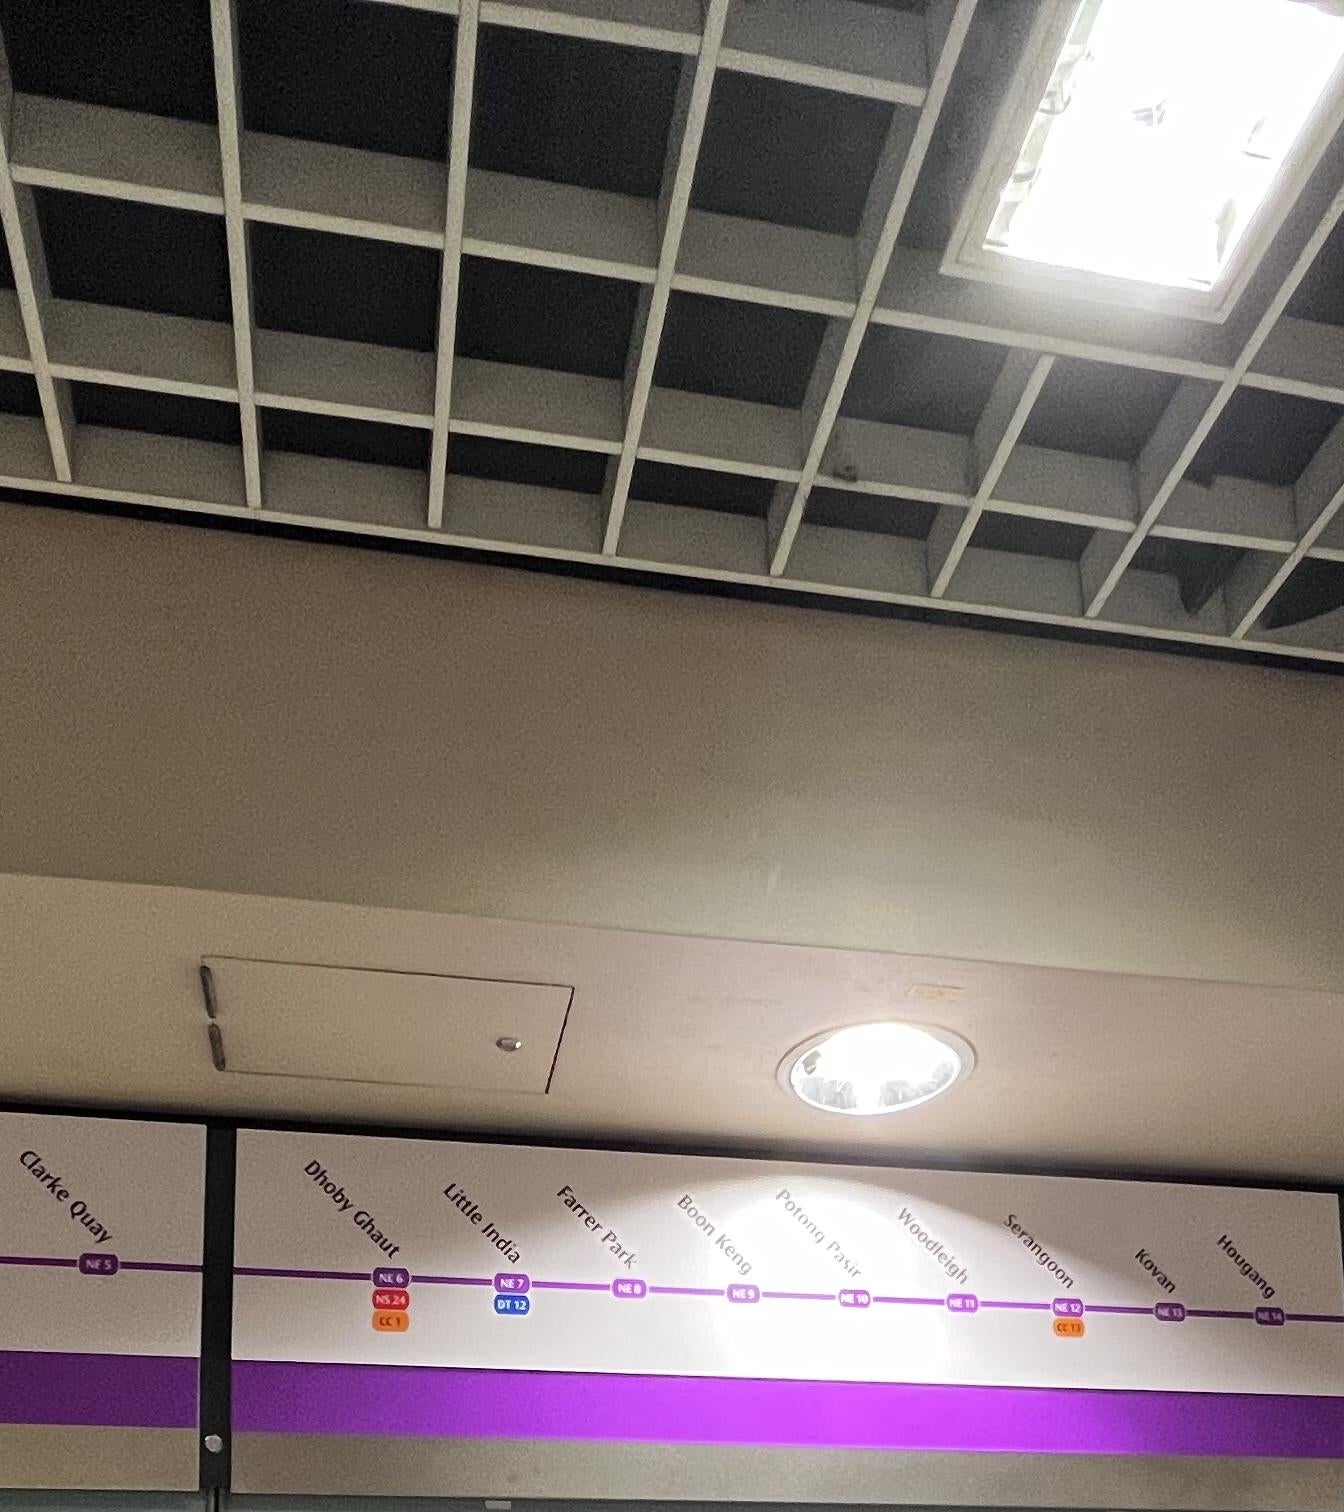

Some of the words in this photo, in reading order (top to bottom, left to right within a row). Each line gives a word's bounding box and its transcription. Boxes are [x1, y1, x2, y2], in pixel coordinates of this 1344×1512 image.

[19, 1150, 70, 1202] Clarke
[69, 1199, 113, 1244] Quay
[304, 1159, 354, 1213] Dhoby
[352, 1210, 400, 1259] Ghaut
[443, 1183, 483, 1226] Little
[480, 1222, 521, 1264] India
[556, 1184, 603, 1231] Farrer
[601, 1228, 639, 1270] Park
[676, 1193, 716, 1237] Boon
[714, 1234, 753, 1277] Keng
[775, 1188, 826, 1244] Potong
[825, 1240, 862, 1278] Pasir
[898, 1207, 968, 1285] Woodleigh
[1003, 1213, 1074, 1289] Serangoon
[1134, 1248, 1176, 1294] Kovan
[1216, 1234, 1276, 1299] Hougang
